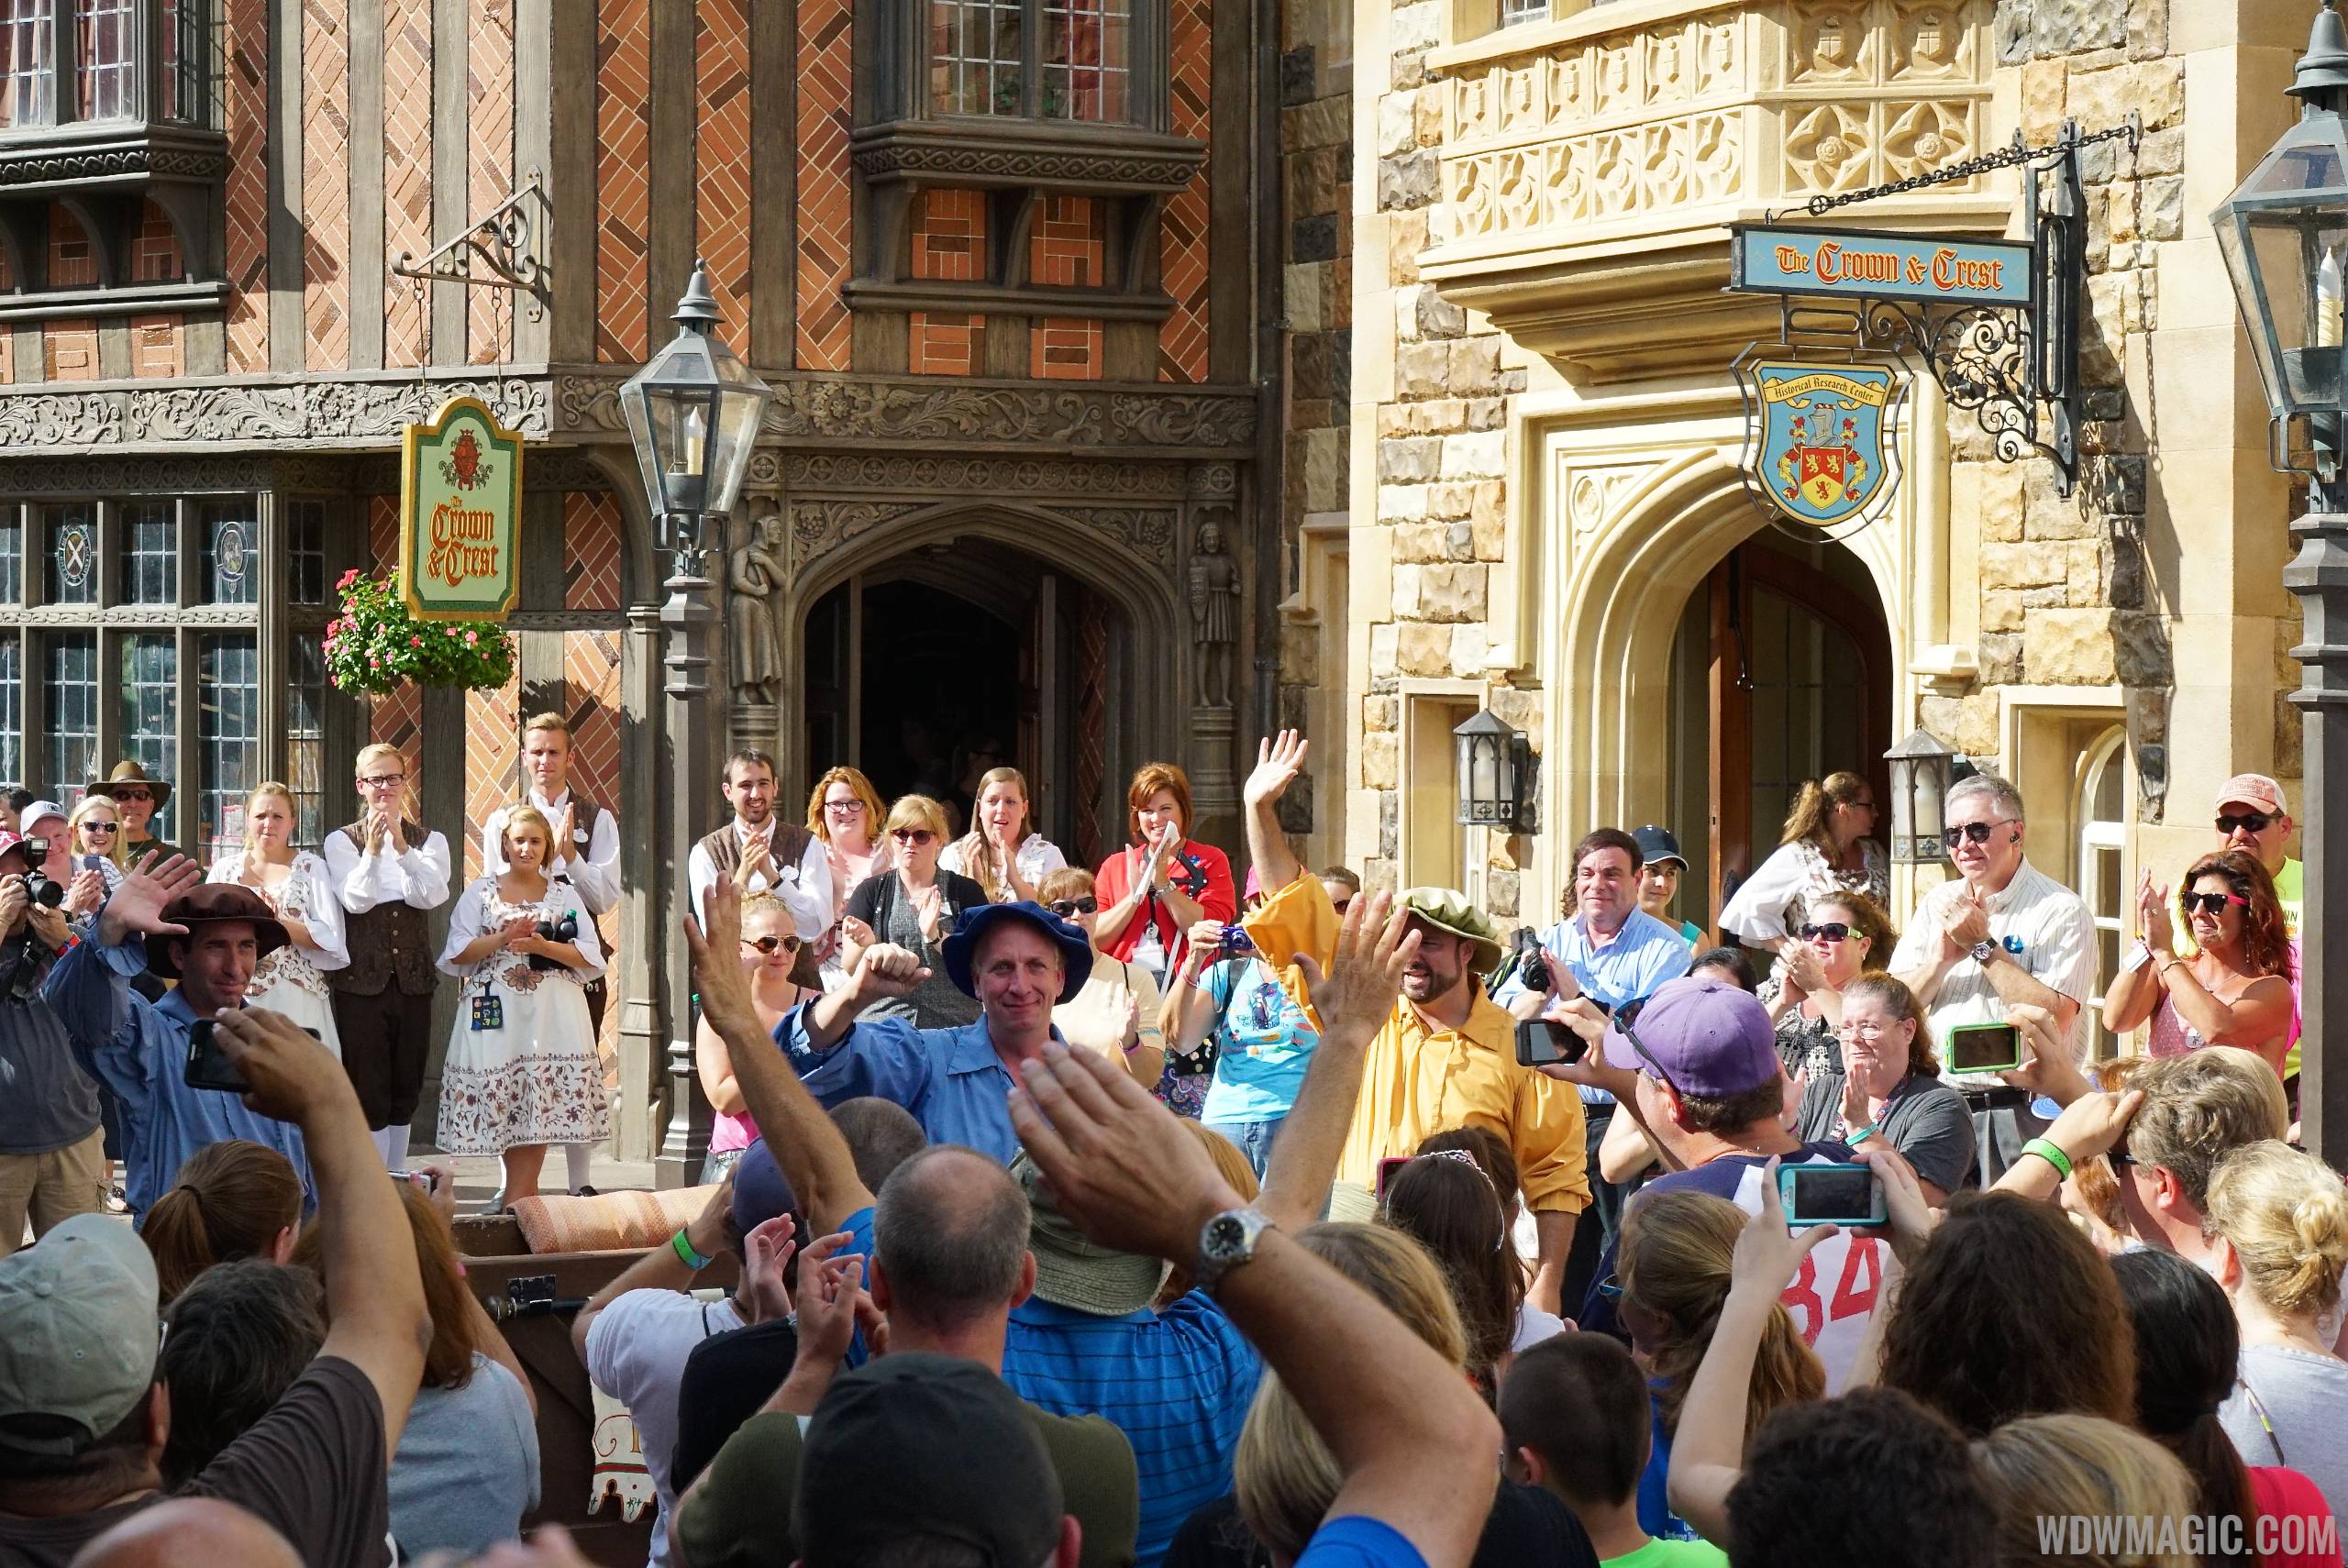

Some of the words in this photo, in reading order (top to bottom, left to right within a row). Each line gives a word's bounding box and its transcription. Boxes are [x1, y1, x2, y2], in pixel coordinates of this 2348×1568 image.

[1776, 246, 1810, 273] The
[1815, 241, 1899, 284] Crown
[1905, 256, 1928, 284] &
[1932, 248, 2004, 293] Crest
[1775, 379, 1811, 398] Historical
[1813, 377, 1848, 392] Research
[1849, 385, 1874, 402] Center
[429, 502, 494, 550] Crown
[426, 548, 444, 580] &
[443, 539, 499, 587] Crest
